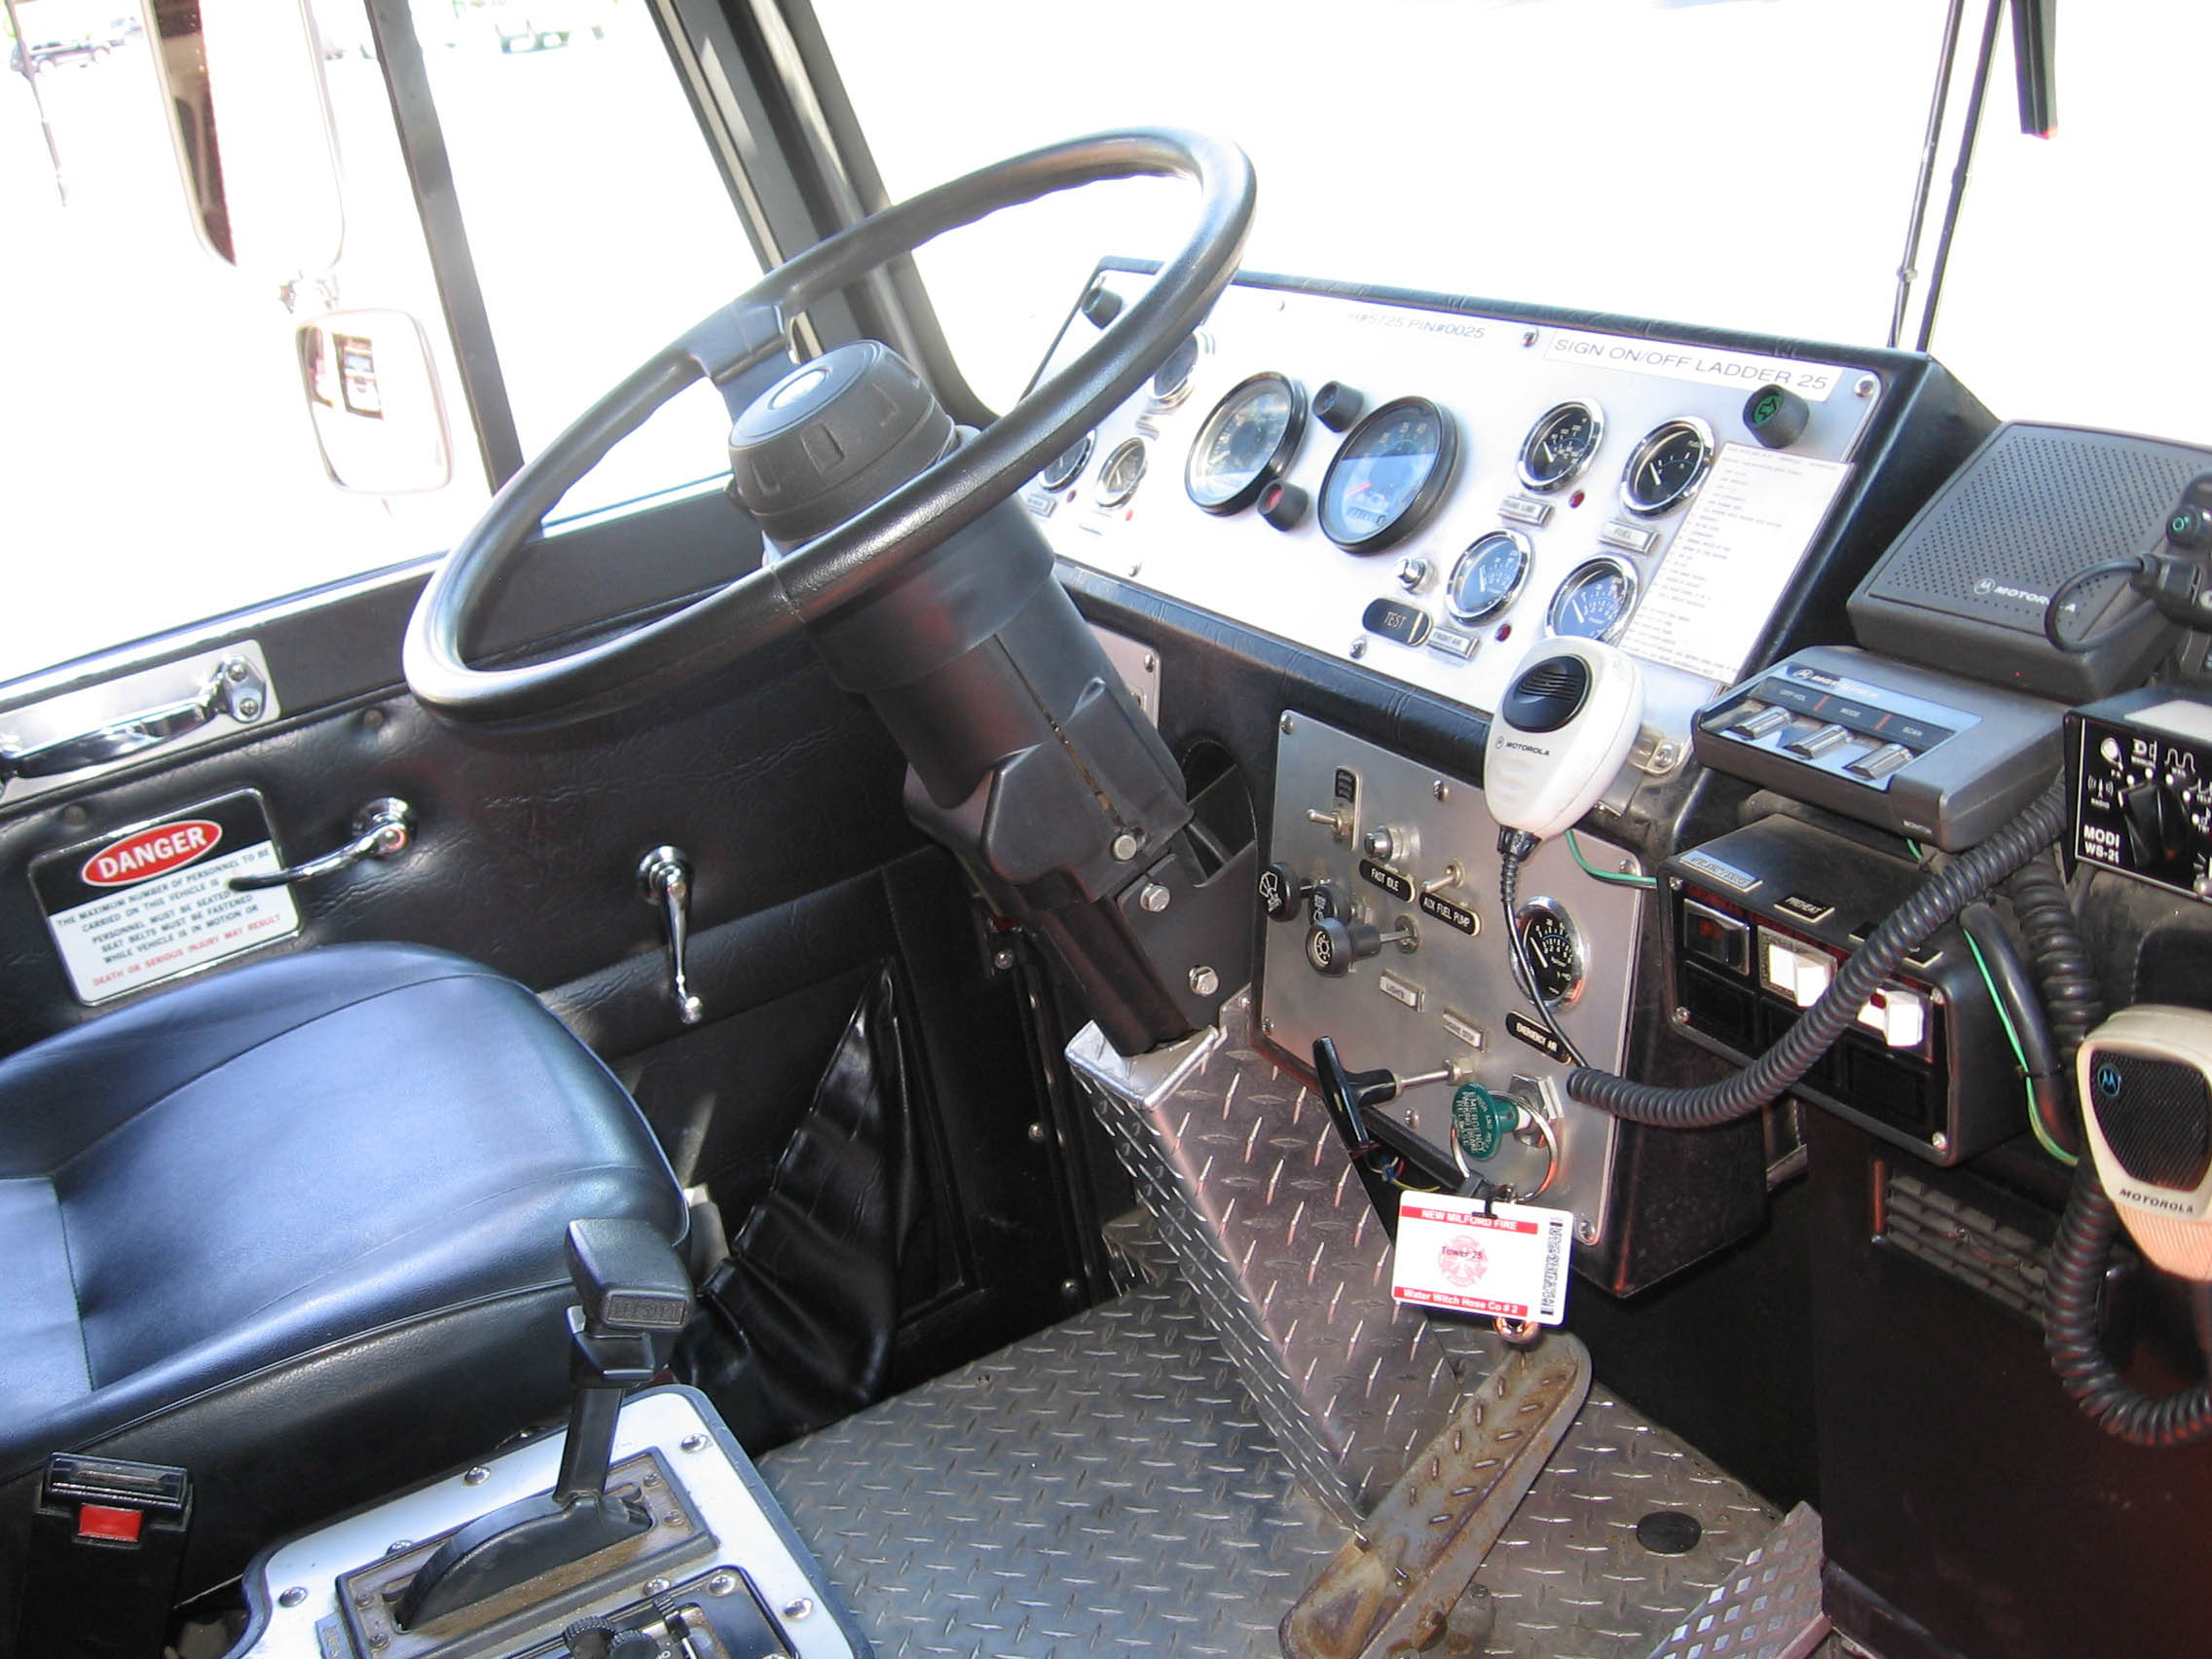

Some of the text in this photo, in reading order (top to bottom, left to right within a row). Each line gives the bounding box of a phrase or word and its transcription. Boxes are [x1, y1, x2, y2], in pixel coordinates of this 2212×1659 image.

[1554, 338, 1829, 390] SIGN ON/OFF LADDER 25
[1382, 610, 1408, 629] TEST
[1505, 742, 1551, 756] MOTOROLA
[98, 826, 207, 879] DANGER
[56, 916, 76, 927] THE
[79, 899, 126, 920] MAXIMUM
[128, 883, 168, 903] NUMBER
[170, 878, 183, 888] OF
[186, 861, 240, 881] PERSONNEL
[1371, 867, 1401, 893] FAST IDLE
[82, 913, 122, 933] CARRIED
[126, 906, 140, 917] ON
[142, 897, 166, 910] THIS
[168, 883, 206, 901] VEHICLE
[92, 920, 145, 943] PERSONNEL
[150, 908, 175, 924] MUST
[197, 890, 231, 907] SEATED
[101, 939, 124, 953] SEAT
[128, 928, 158, 943] BELTS
[161, 916, 186, 931] MUST
[206, 895, 253, 915] FASTENED
[1436, 903, 1453, 921] FUEL
[1453, 910, 1471, 929] PUMP
[93, 970, 125, 987] DEATH
[145, 948, 184, 968] SERIOUS
[188, 935, 220, 952] INJURY
[223, 926, 244, 940] MAY
[247, 912, 281, 931] RESULT
[103, 948, 133, 965] WHILE
[137, 934, 174, 952] VEHICLE
[205, 910, 242, 928] MOTION
[244, 903, 259, 914] OR
[2119, 1187, 2194, 1214] MOTOROLA
[1421, 1209, 1519, 1231] NEW MILFORD FIRE
[1442, 1246, 1469, 1258] Tower
[1403, 1287, 1432, 1301] Water
[1432, 1293, 1461, 1306] Witch
[1461, 1296, 1488, 1309] Hose
[1488, 1301, 1502, 1311] Co
[1511, 1305, 1520, 1314] 2
